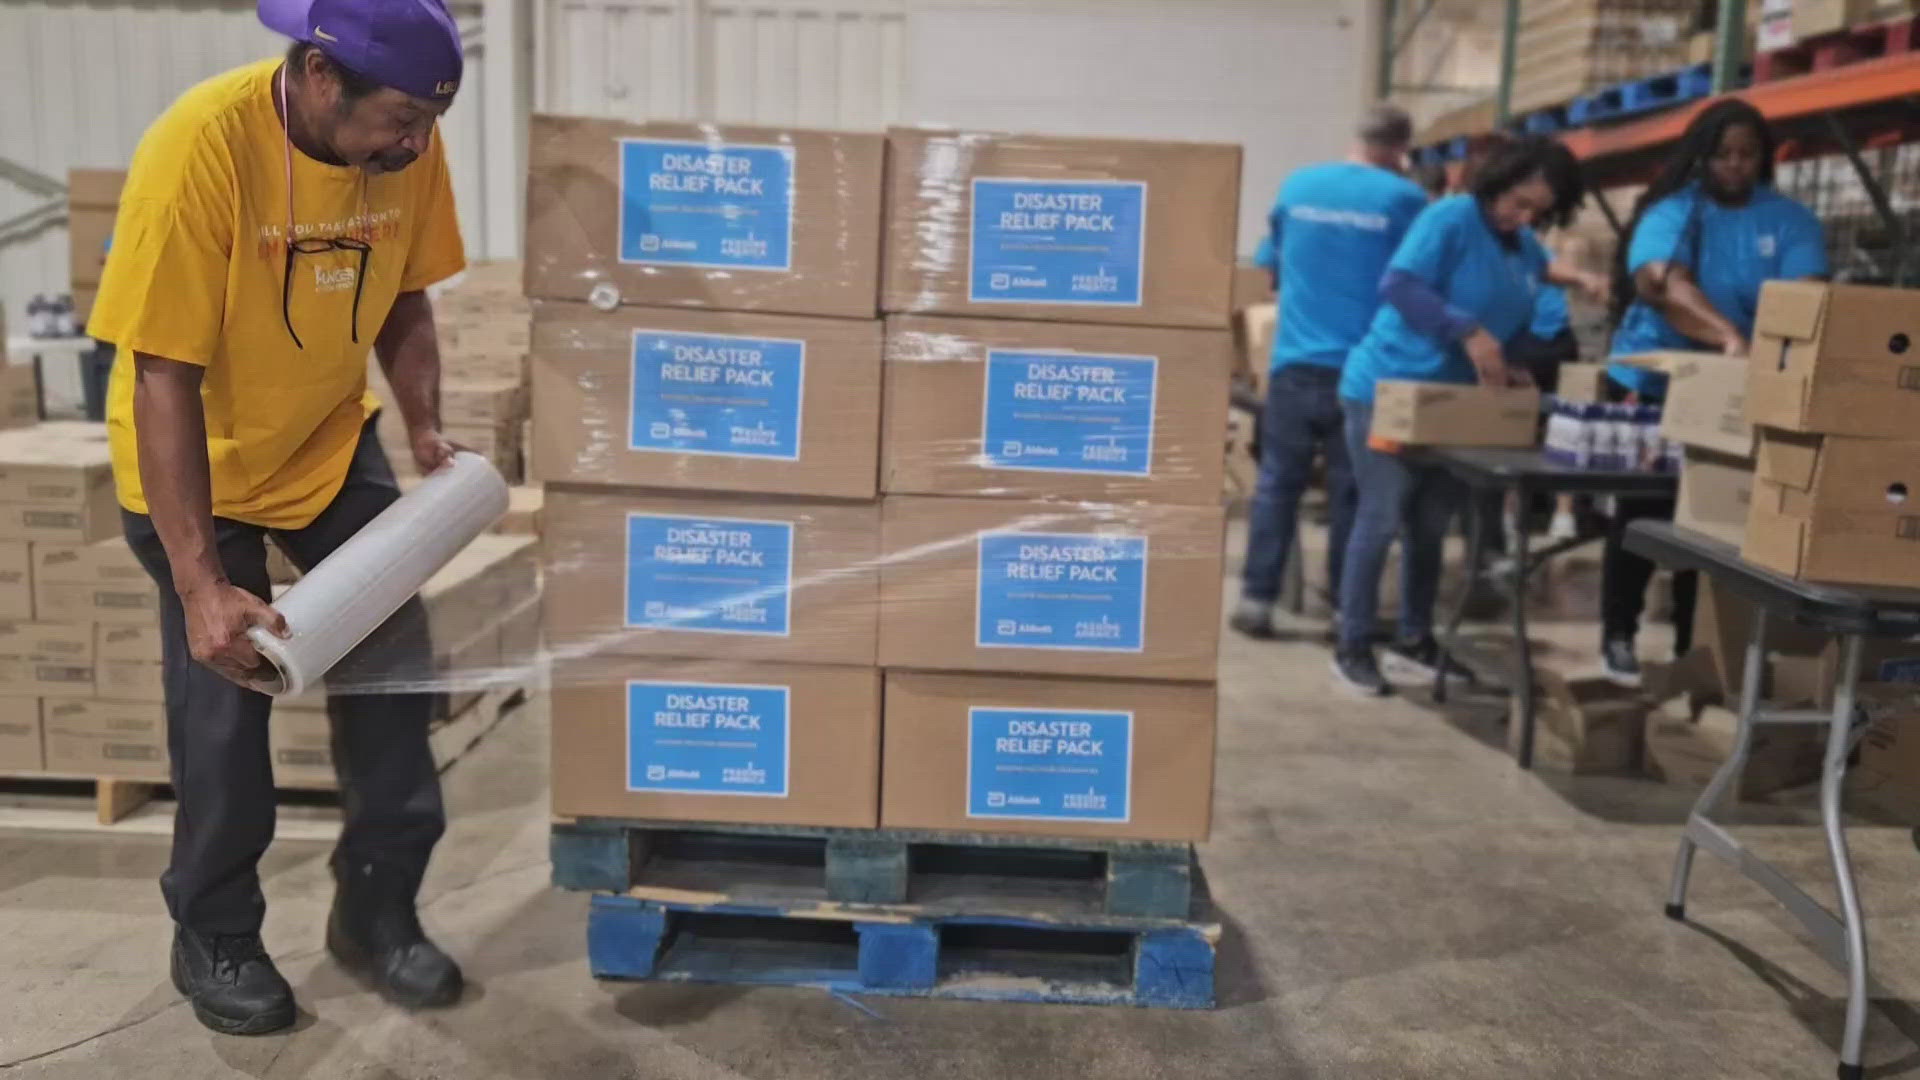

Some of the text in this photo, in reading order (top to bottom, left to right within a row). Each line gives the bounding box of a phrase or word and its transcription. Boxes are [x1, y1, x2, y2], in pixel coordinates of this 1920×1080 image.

[663, 153, 751, 175] DISASTER
[649, 174, 763, 196] RELIEF PACK
[1014, 192, 1102, 211] DISASTER
[1000, 212, 1114, 232] RELIEF PACK
[675, 346, 762, 366] DISASTER
[662, 364, 774, 386] RELIEF PACK
[1028, 363, 1115, 385] DISASTER
[1014, 382, 1126, 403] RELIEF PACK
[667, 528, 752, 547] DISASTER
[654, 545, 764, 566] RELIEF PACK
[1019, 545, 1105, 563] DISASTER
[1007, 562, 1117, 582] RELIEF PACK
[667, 694, 750, 712] DISASTER
[654, 712, 760, 730] RELIEF PACK
[1008, 721, 1092, 737] DISASTER
[996, 737, 1104, 755] RELIEF PACK
